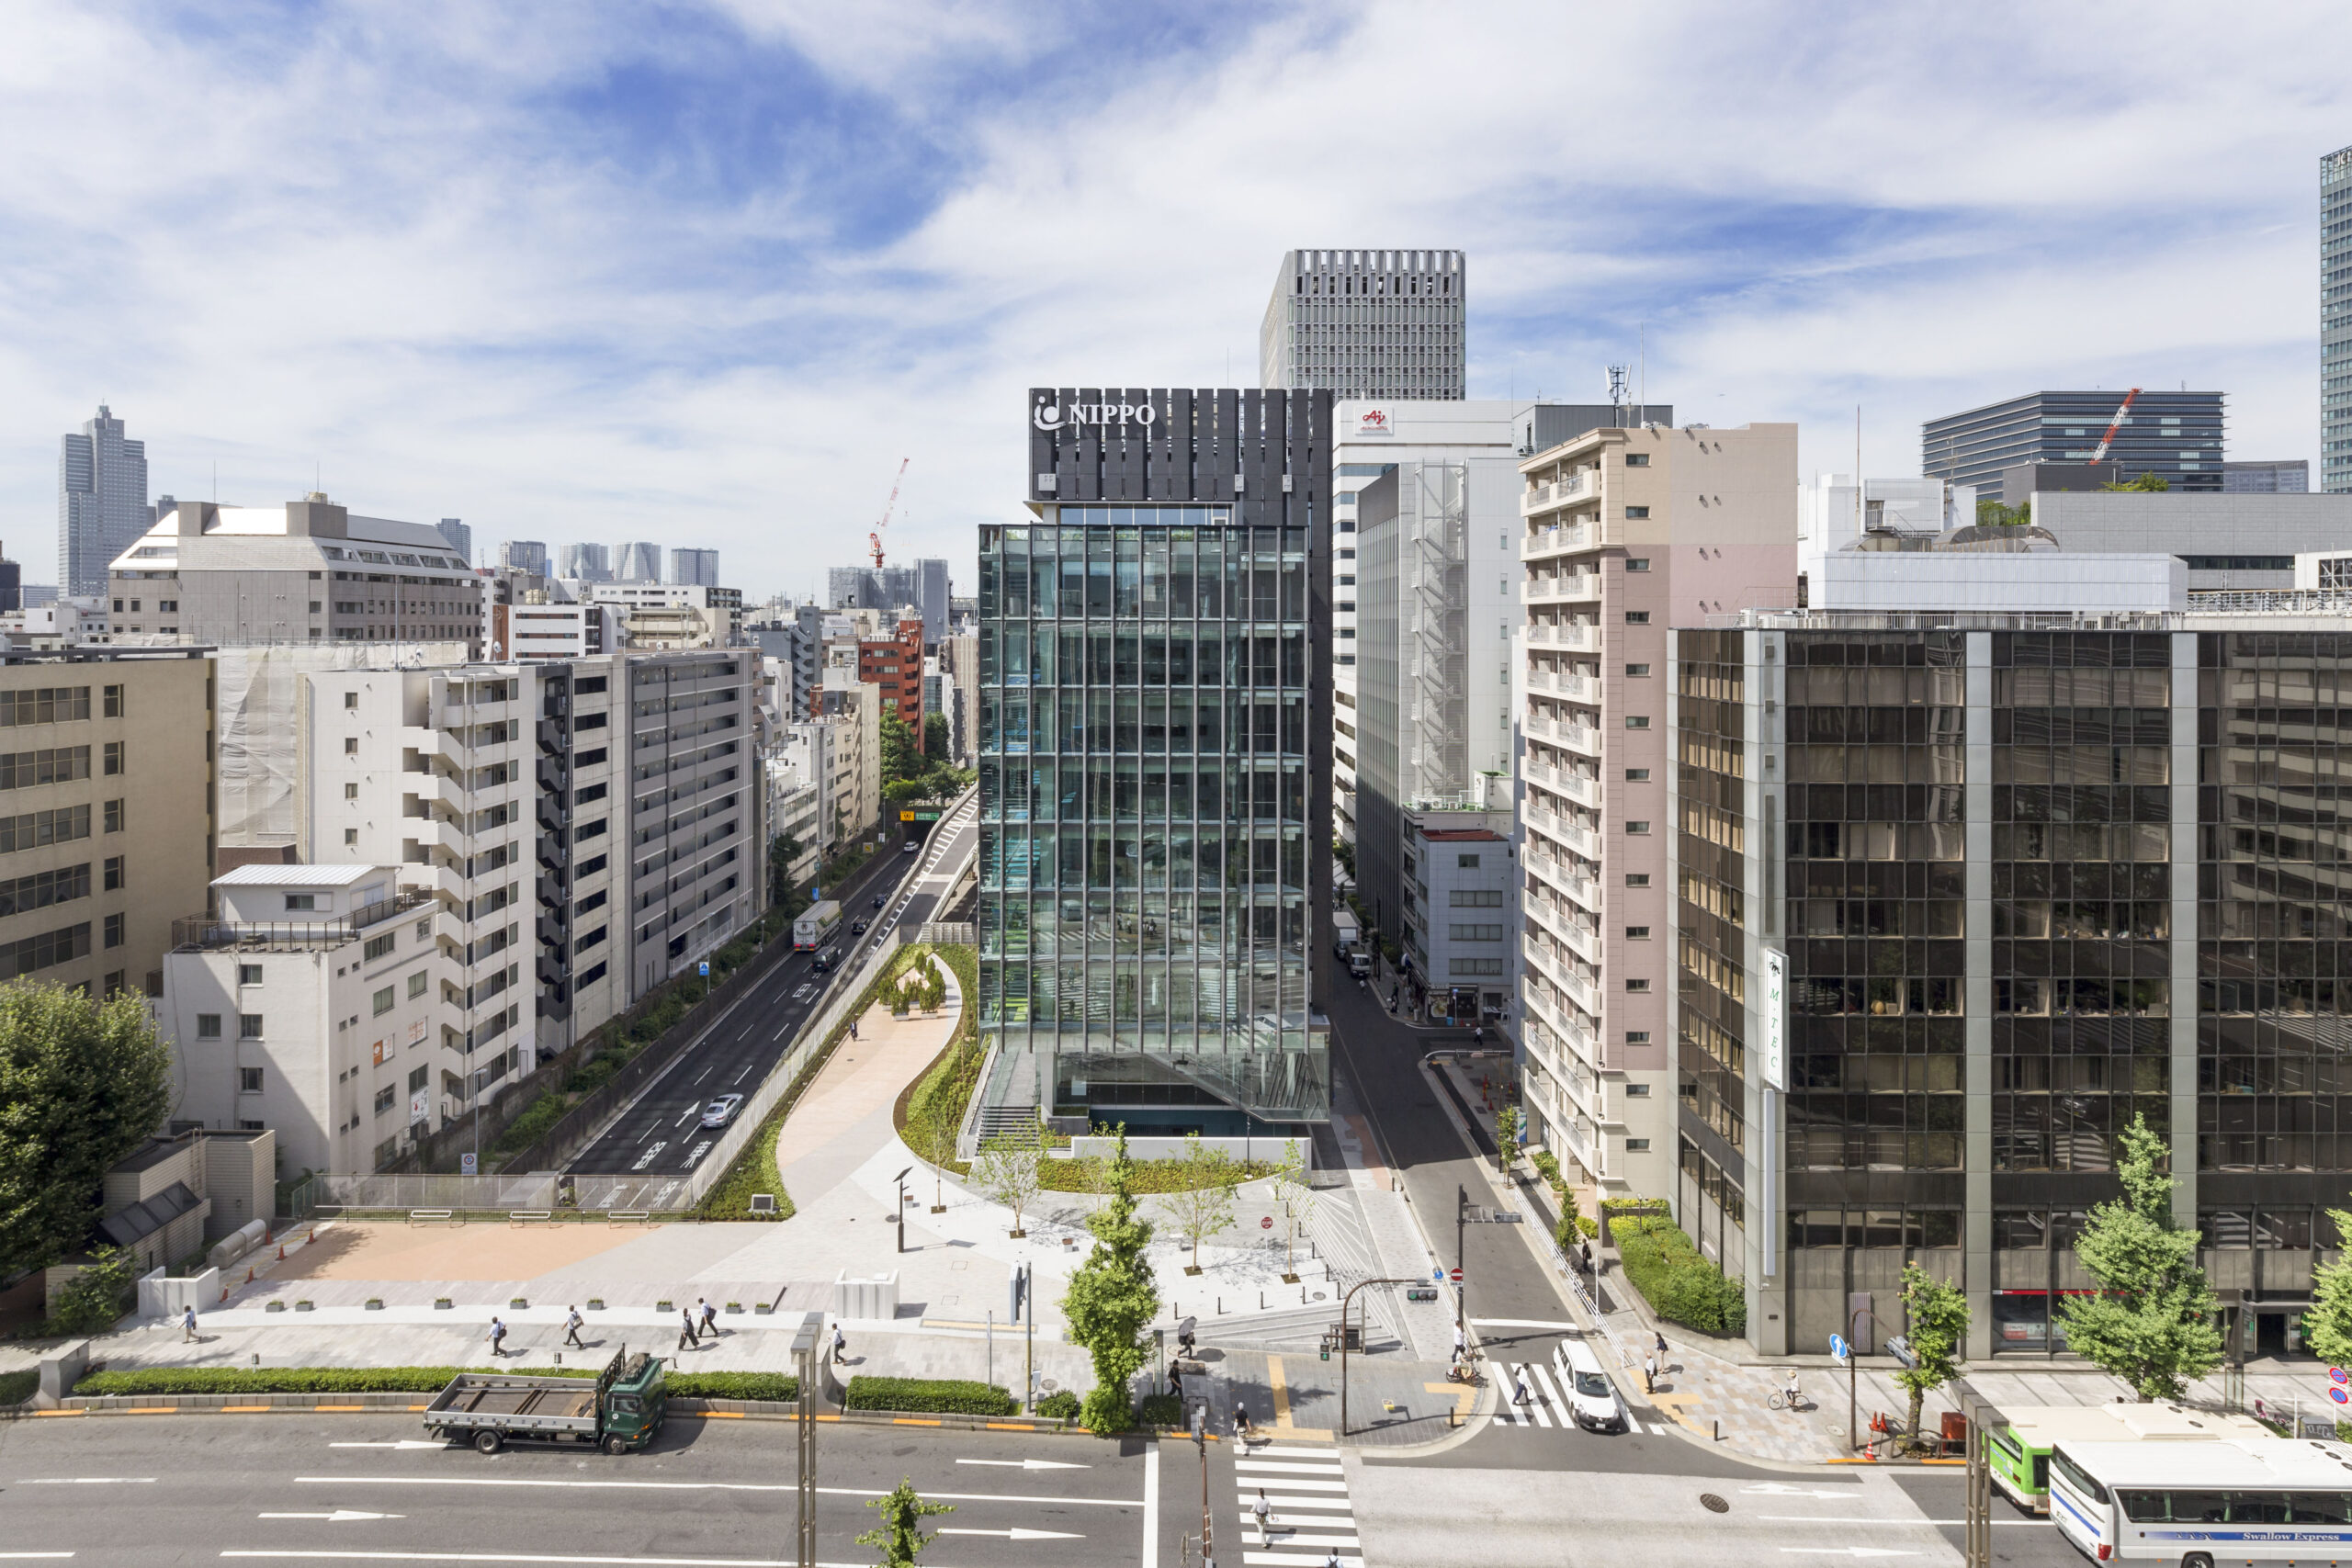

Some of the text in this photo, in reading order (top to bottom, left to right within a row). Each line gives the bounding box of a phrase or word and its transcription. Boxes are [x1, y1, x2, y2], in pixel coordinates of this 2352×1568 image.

[1069, 404, 1156, 424] NIPPO
[2243, 1532, 2340, 1541] Swallow Express
